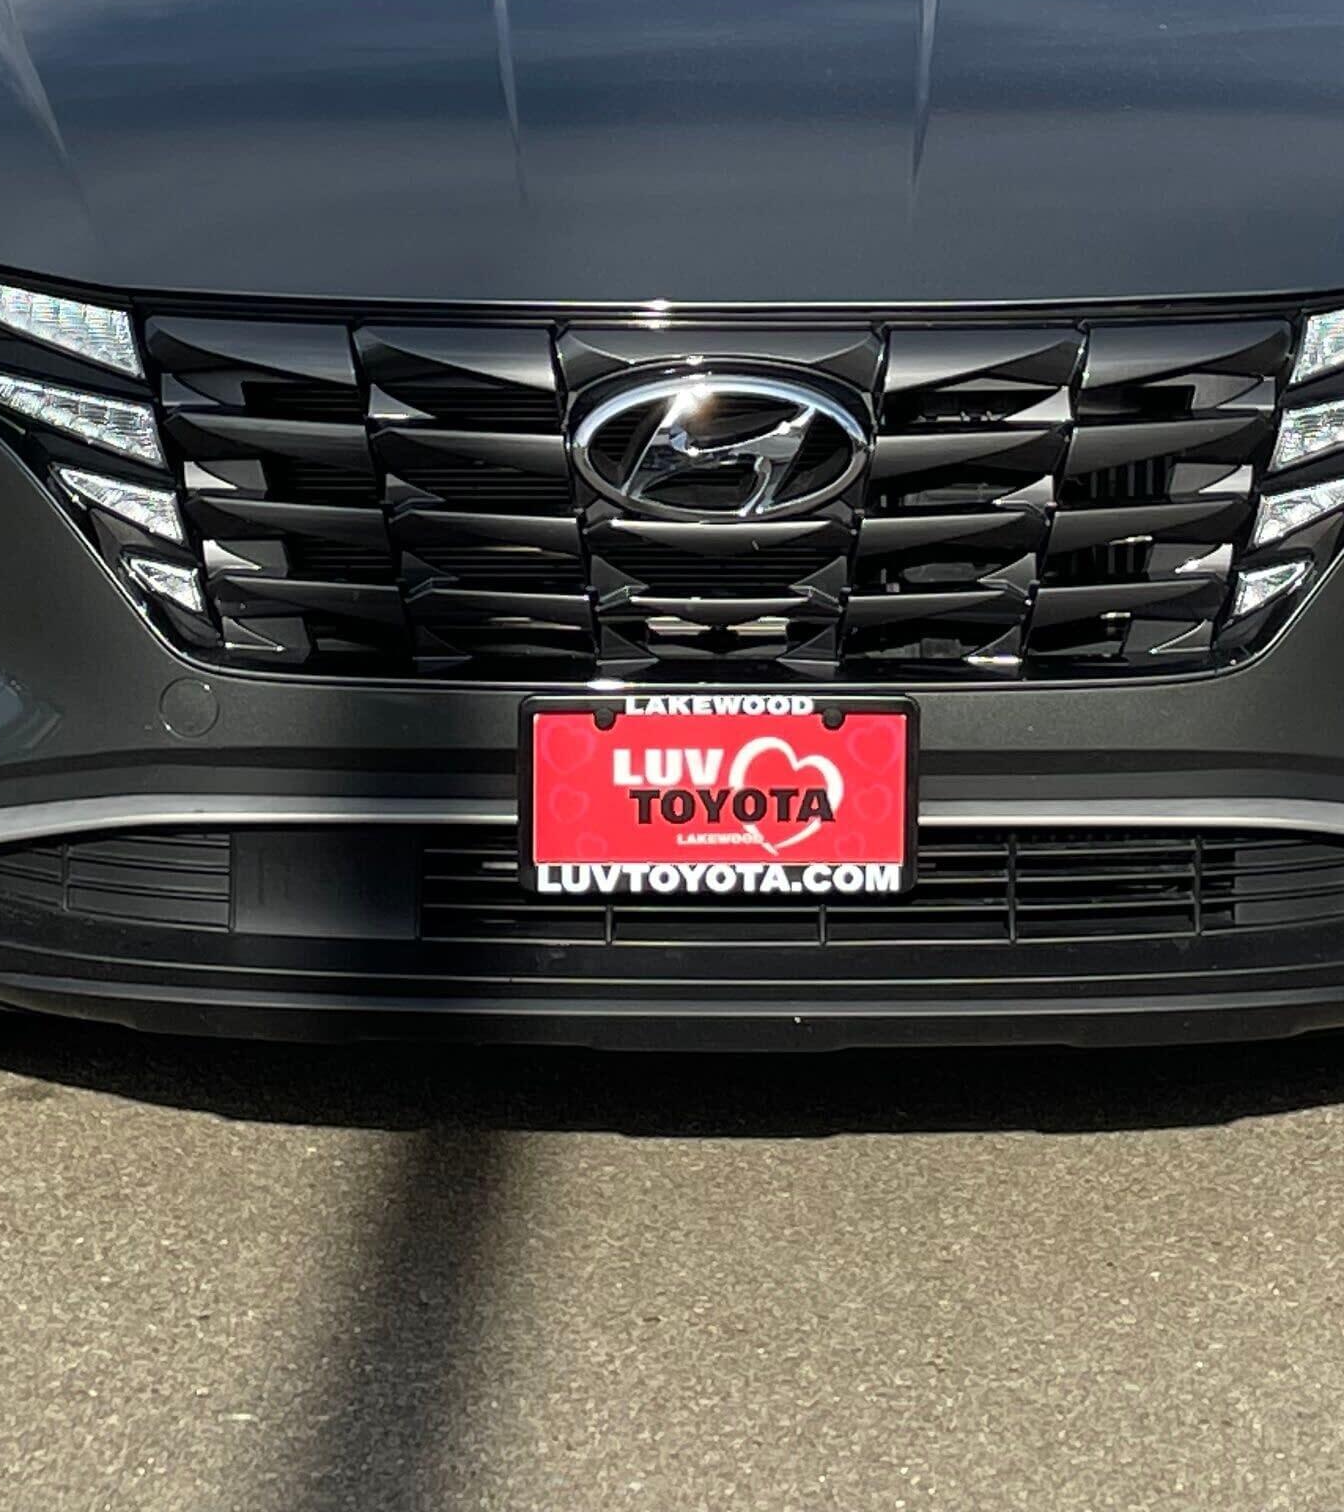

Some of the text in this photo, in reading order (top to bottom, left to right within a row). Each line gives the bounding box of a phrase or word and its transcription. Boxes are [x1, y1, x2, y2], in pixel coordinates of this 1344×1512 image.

[625, 694, 815, 716] LAKEWOOD
[612, 748, 724, 786] LUV
[629, 788, 836, 825] TOYOTA
[537, 863, 900, 894] LUVTOYOTA.COM
